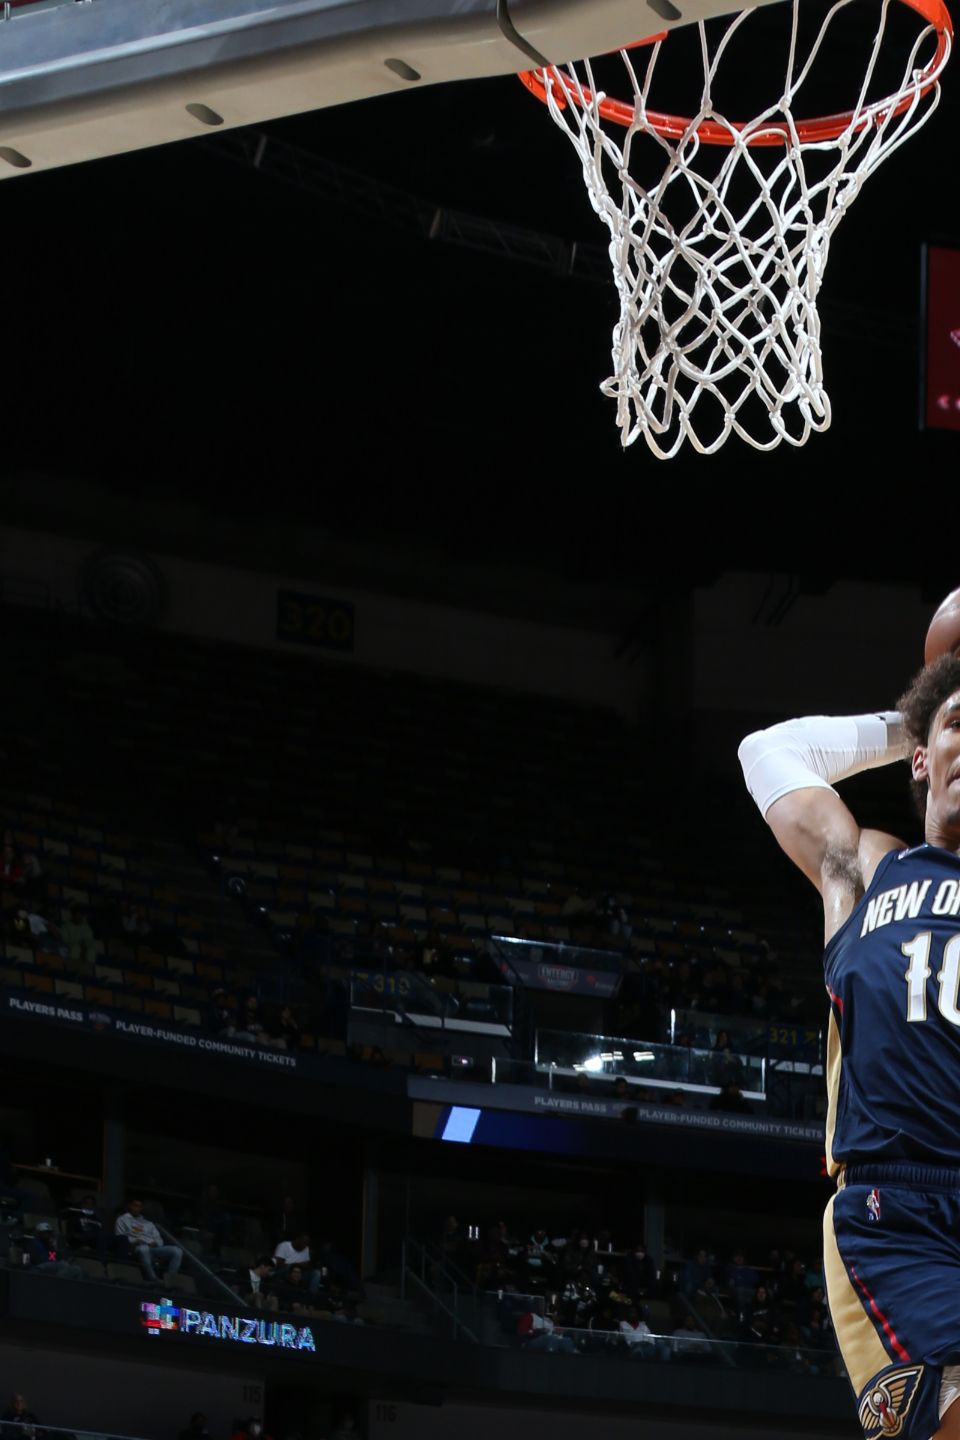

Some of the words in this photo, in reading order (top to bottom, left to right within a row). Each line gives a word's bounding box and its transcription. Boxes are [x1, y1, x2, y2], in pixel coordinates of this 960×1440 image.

[860, 879, 932, 938] NEW
[9, 998, 55, 1017] PLAYERS
[57, 1008, 84, 1023] PASS
[116, 1020, 197, 1047] PLAYER-FUNDED
[198, 1038, 257, 1059] COMMUNITY
[258, 1051, 297, 1068] TICKETS
[534, 1096, 580, 1112] PLAYERS
[722, 1119, 783, 1135] COMMUNITY
[783, 1125, 823, 1139] TICKETS
[180, 1307, 316, 1351] PANZURA
